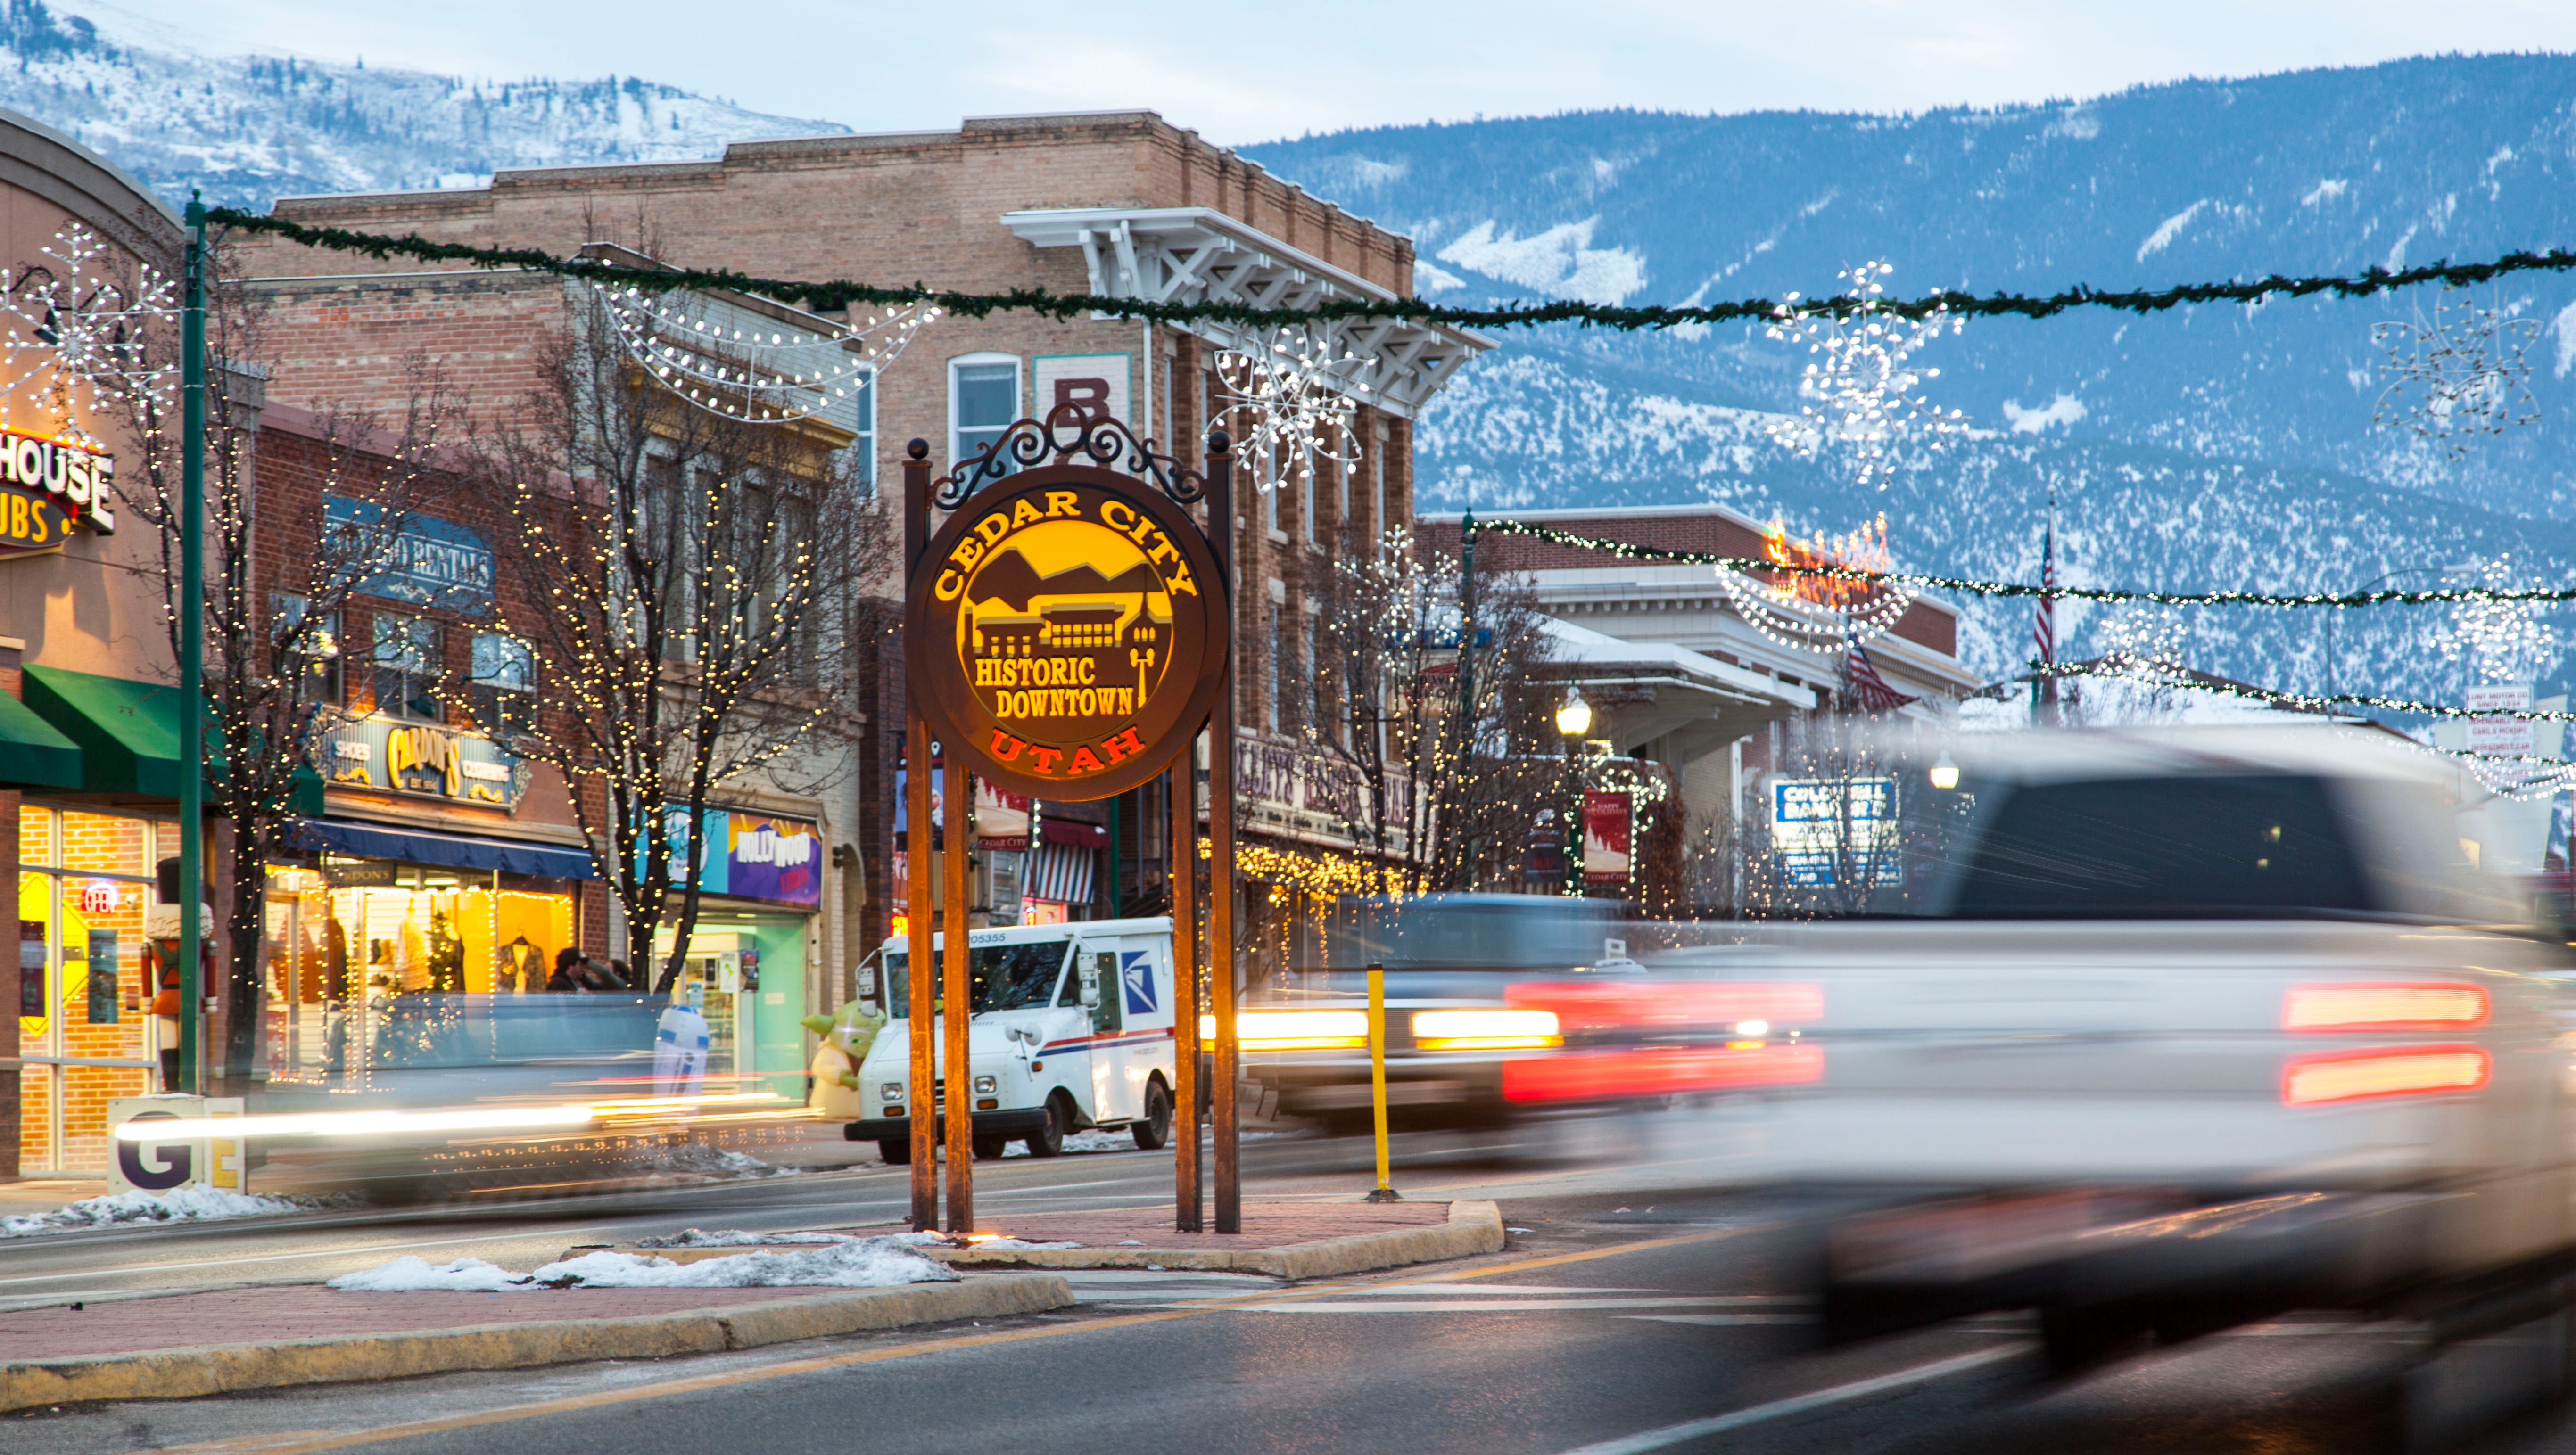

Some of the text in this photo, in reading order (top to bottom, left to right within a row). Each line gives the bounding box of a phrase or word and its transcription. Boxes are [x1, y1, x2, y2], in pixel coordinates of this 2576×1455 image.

[0, 433, 114, 530] HOUSE
[413, 541, 489, 587] RENTALS
[935, 491, 1197, 601] CEDAR CITY
[975, 657, 1095, 686] HISTORIC
[996, 687, 1133, 718] DOWNTOWN
[335, 740, 371, 761] SHOES
[991, 726, 1145, 774] UTAH
[979, 837, 1026, 847] CEDAR CITY
[780, 866, 808, 895] VIDEO
[118, 1111, 191, 1189] G
